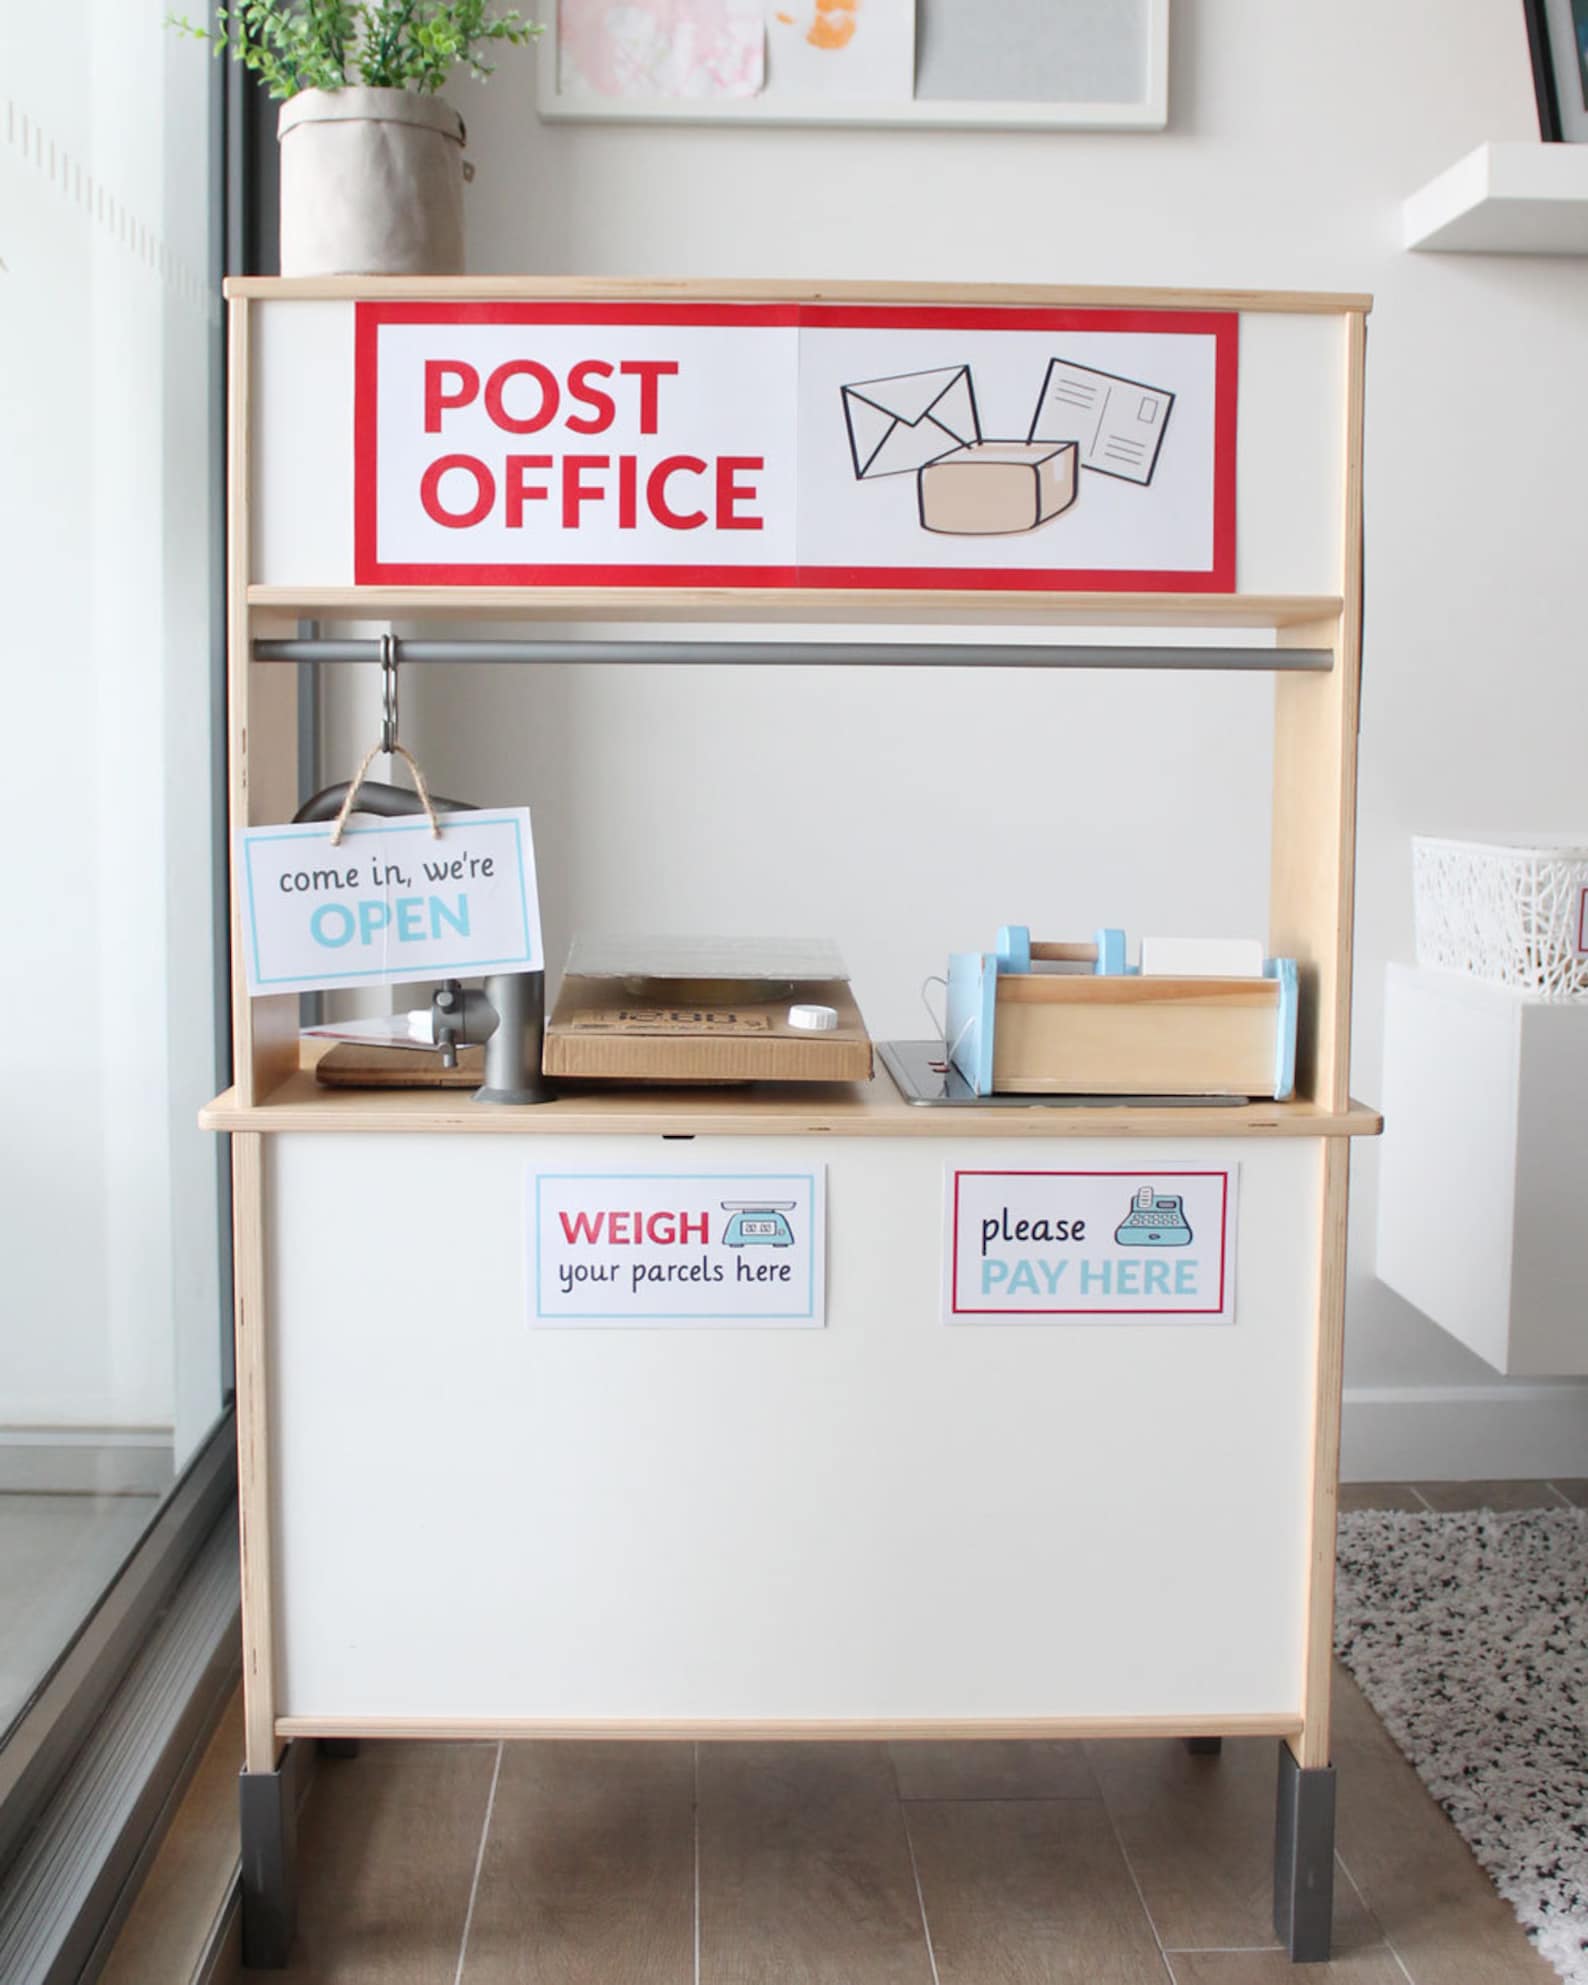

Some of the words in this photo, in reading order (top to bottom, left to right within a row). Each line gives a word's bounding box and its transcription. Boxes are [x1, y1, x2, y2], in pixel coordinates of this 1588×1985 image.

[423, 358, 680, 436] POST
[419, 453, 765, 531] OFFICE
[279, 867, 360, 893] come
[371, 856, 412, 888] in,
[421, 850, 495, 882] we're
[309, 893, 471, 949] OPEN
[557, 1210, 710, 1246] WEIGH
[981, 1206, 1086, 1257] please
[558, 1262, 621, 1294] your
[631, 1254, 725, 1294] parcels
[735, 1254, 792, 1283] here
[980, 1258, 1069, 1296] PAY
[1079, 1258, 1199, 1296] HERE
